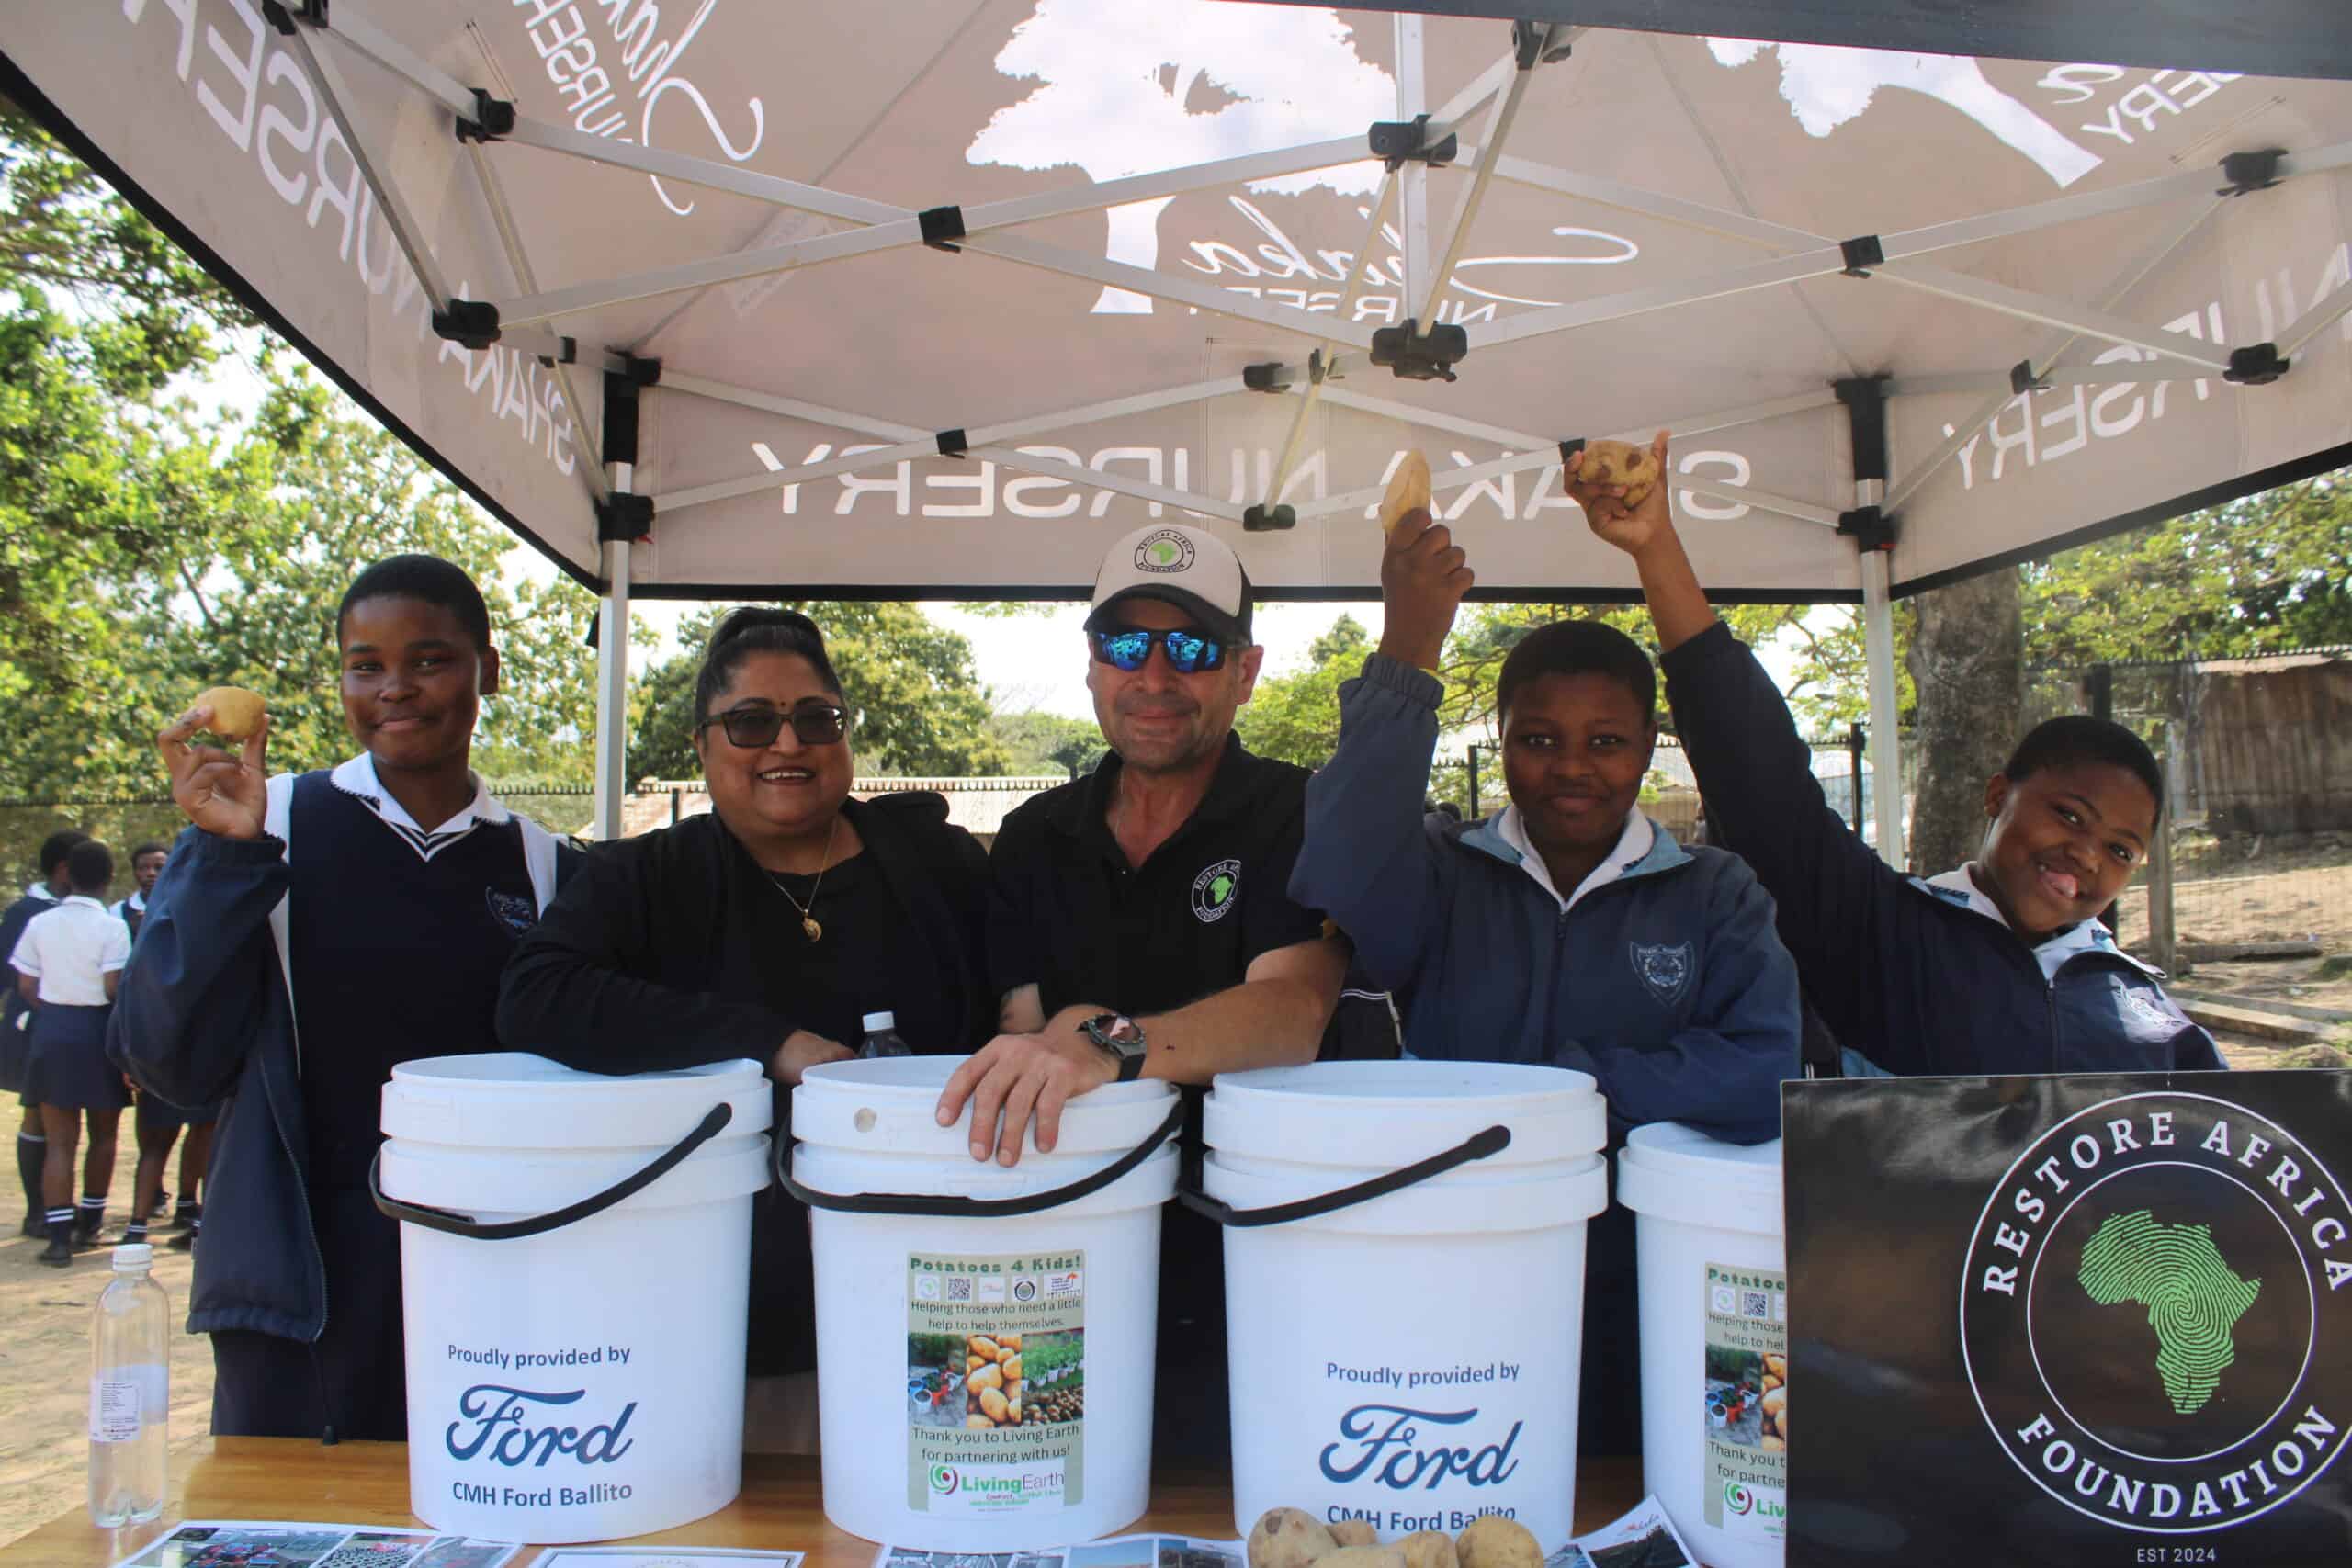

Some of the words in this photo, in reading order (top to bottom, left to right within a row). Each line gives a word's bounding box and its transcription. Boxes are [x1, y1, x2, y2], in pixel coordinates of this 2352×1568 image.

[1983, 1111, 2176, 1296] RESTORE
[2201, 1120, 2352, 1291] AFRICA
[1012, 1259, 1024, 1272] 4
[1033, 1255, 1080, 1271] Kids!
[911, 1300, 954, 1315] Helping
[956, 1301, 989, 1314] those
[991, 1301, 1016, 1314] who
[1019, 1299, 1048, 1313] need
[1049, 1302, 1056, 1312] a
[1057, 1297, 1081, 1309] little
[928, 1318, 953, 1331] help
[956, 1320, 967, 1330] to
[971, 1319, 997, 1331] help
[1709, 1312, 1749, 1331] Helping
[1751, 1320, 1784, 1334] those
[1724, 1331, 1748, 1347] help
[1750, 1336, 1763, 1347] to
[447, 1344, 510, 1370] Proudly
[515, 1345, 602, 1370] provided
[608, 1345, 631, 1364] by
[1327, 1361, 1403, 1389] Proudly
[1408, 1363, 1495, 1389] provided
[1499, 1361, 1521, 1382] by
[446, 1383, 639, 1467] Ford
[913, 1427, 951, 1441] Thank
[956, 1431, 981, 1445] you
[985, 1430, 1000, 1443] to
[1003, 1427, 1044, 1443] Living
[1046, 1425, 1080, 1438] Earth
[922, 1447, 942, 1461] for
[944, 1449, 1017, 1463] partnering
[1021, 1446, 1049, 1461] with
[1052, 1444, 1070, 1457] us!
[1319, 1404, 1524, 1490] Ford
[1709, 1439, 1747, 1461] Thank
[1749, 1453, 1776, 1467] you
[1717, 1463, 1736, 1478] for
[2017, 1405, 2338, 1519] FOUNDATION
[452, 1482, 497, 1505] CMH
[503, 1487, 552, 1507] Ford
[560, 1483, 633, 1506] Ballito
[1327, 1505, 1381, 1529] CMH
[1390, 1511, 1442, 1531] Ford
[2137, 1547, 2166, 1562] EST
[2173, 1547, 2216, 1562] 2024
